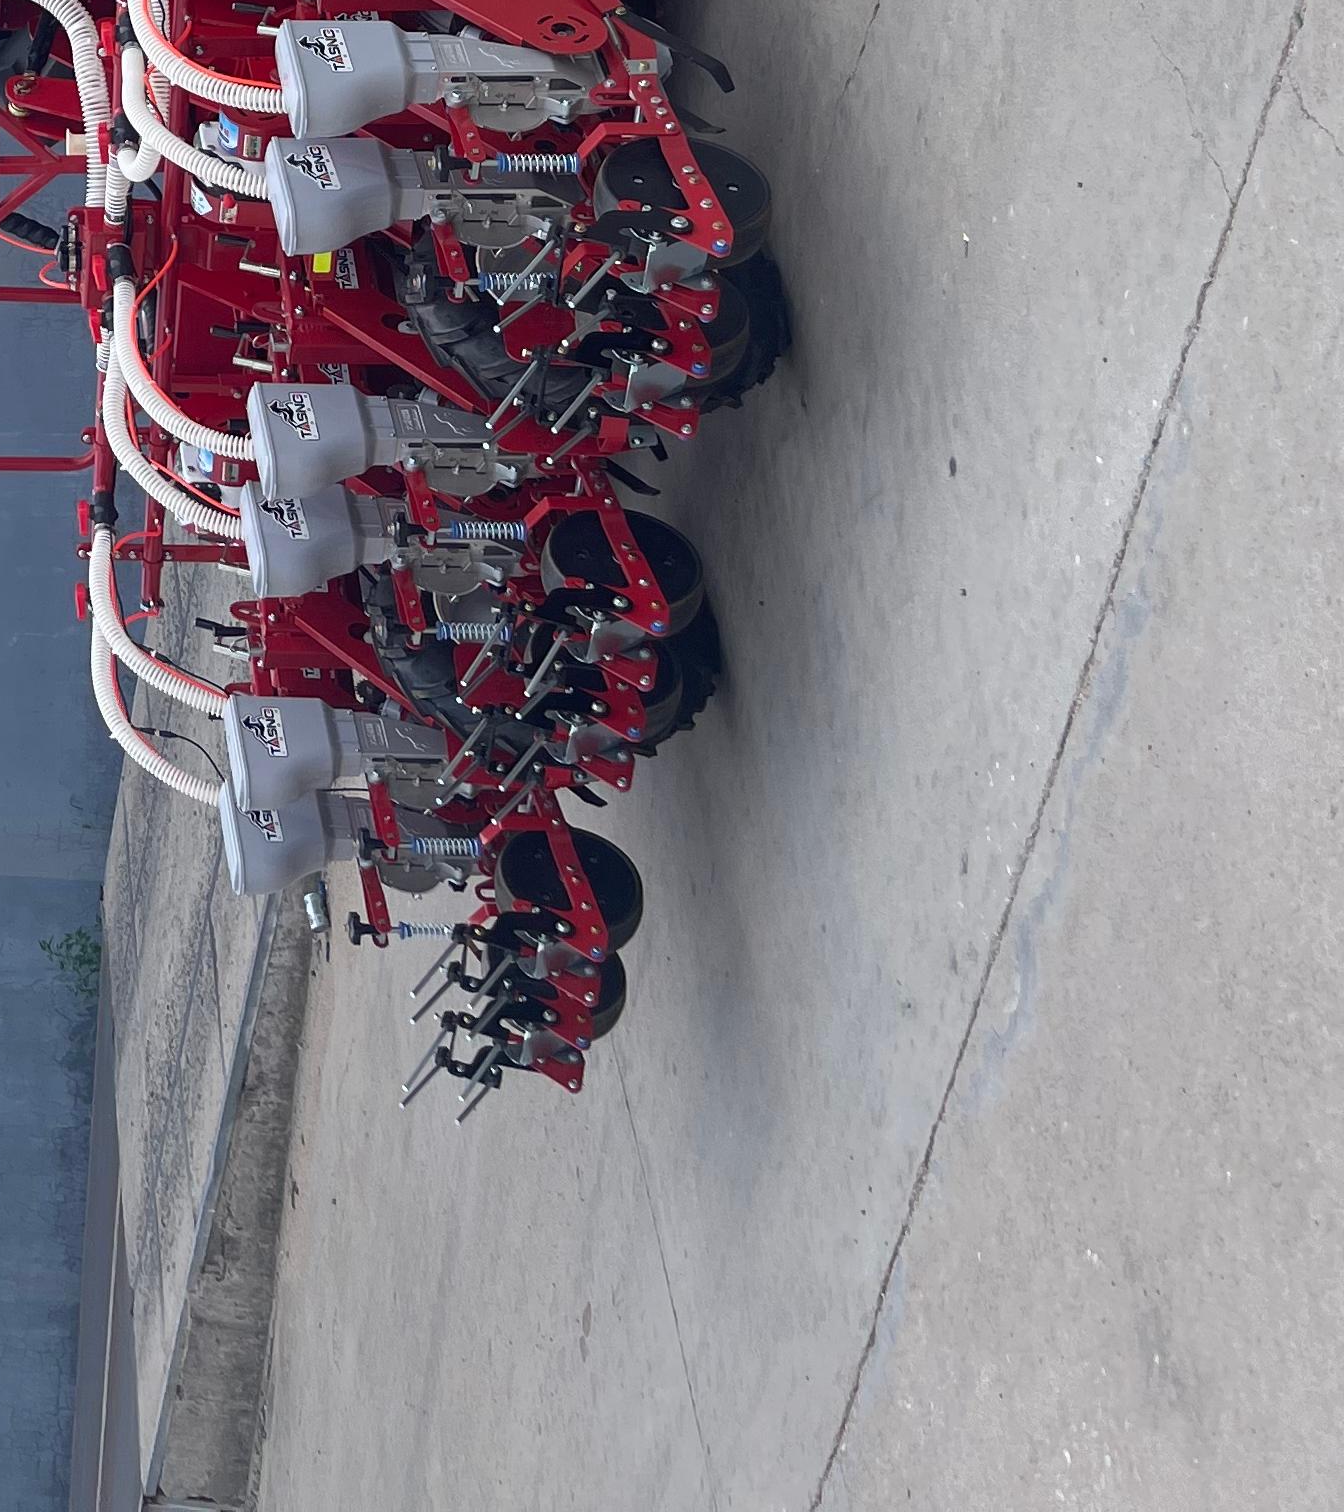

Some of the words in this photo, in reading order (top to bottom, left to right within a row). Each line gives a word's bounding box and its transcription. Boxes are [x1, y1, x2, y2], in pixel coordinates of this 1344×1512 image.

[323, 29, 345, 71] TASNG
[310, 146, 332, 188] TASNG
[337, 249, 351, 289] TASNG
[292, 394, 311, 439] TASNG
[263, 708, 280, 755] TASNG
